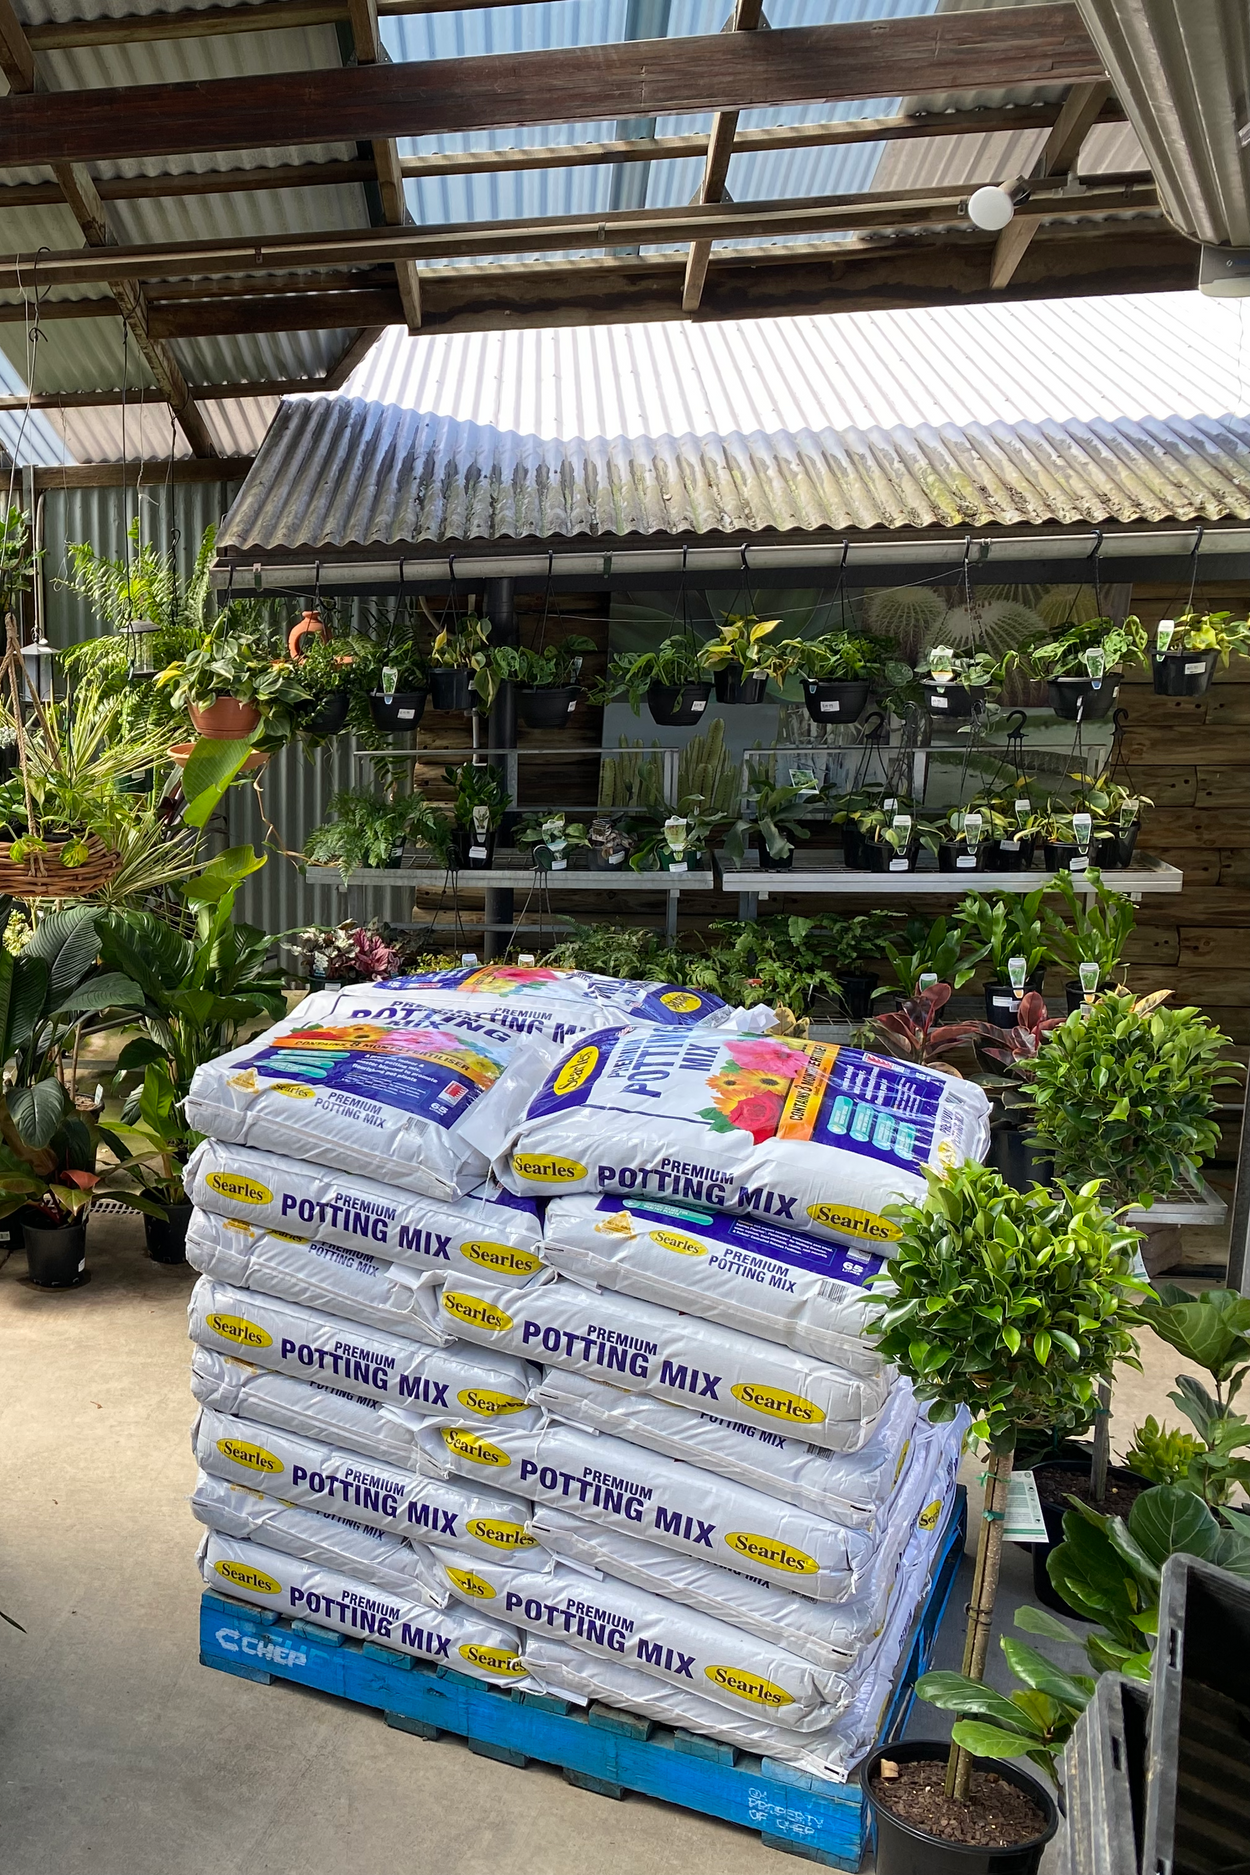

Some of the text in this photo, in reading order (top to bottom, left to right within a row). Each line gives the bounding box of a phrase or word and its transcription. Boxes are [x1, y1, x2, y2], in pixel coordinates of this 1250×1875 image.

[494, 1007, 553, 1021] PREMIUM
[557, 1050, 592, 1091] Searles
[620, 1026, 694, 1099] POTTING
[679, 1043, 721, 1072] MIX
[274, 1084, 308, 1098] Searles
[328, 1092, 383, 1116] PREMIUM
[314, 1098, 387, 1129] POTTING MIX
[431, 1102, 448, 1114] 65
[515, 1157, 575, 1178] Searles
[661, 1158, 734, 1184] PREMIUM
[212, 1173, 264, 1202] Searles
[598, 1165, 798, 1221] POTTING MIX
[334, 1192, 396, 1221] PREMIUM
[282, 1192, 452, 1260] POTTING MIX
[816, 1206, 889, 1239] Searles
[655, 1232, 699, 1254] Searles
[308, 1244, 380, 1278] POTTING MIX
[469, 1244, 534, 1273] Searles
[724, 1248, 789, 1277] PREMIUM
[842, 1261, 864, 1274] 65
[708, 1255, 796, 1294] POTTING MIX
[444, 1294, 502, 1328] Searles
[212, 1316, 264, 1345] Searles
[587, 1324, 658, 1356] PREMIUM
[334, 1340, 396, 1370] PREMIUM
[522, 1320, 723, 1401] POTTING MIX
[281, 1338, 450, 1408] POTTING MIX
[356, 1395, 380, 1410] MIX
[741, 1386, 813, 1420] Searles
[446, 1428, 501, 1463] Searles
[758, 1429, 787, 1450] MIX
[224, 1441, 275, 1470] Searles
[345, 1468, 405, 1498] PREMIUM
[583, 1466, 653, 1500] PREMIUM
[293, 1465, 459, 1538] POTTING MIX
[520, 1458, 717, 1549] POTTING MIX
[362, 1524, 386, 1542] MIX
[475, 1521, 537, 1546] Searles
[734, 1534, 806, 1571] Searles
[221, 1563, 273, 1592] Searles
[342, 1590, 400, 1620] PREMIUM
[567, 1598, 634, 1633] PREMIUM
[290, 1586, 452, 1660] POTTING MIX
[506, 1592, 696, 1680] POTTING MIX
[241, 1636, 307, 1668] CHEP
[714, 1668, 782, 1706] Searles
[748, 1797, 824, 1828] PROPERTY
[749, 1810, 768, 1821] OF
